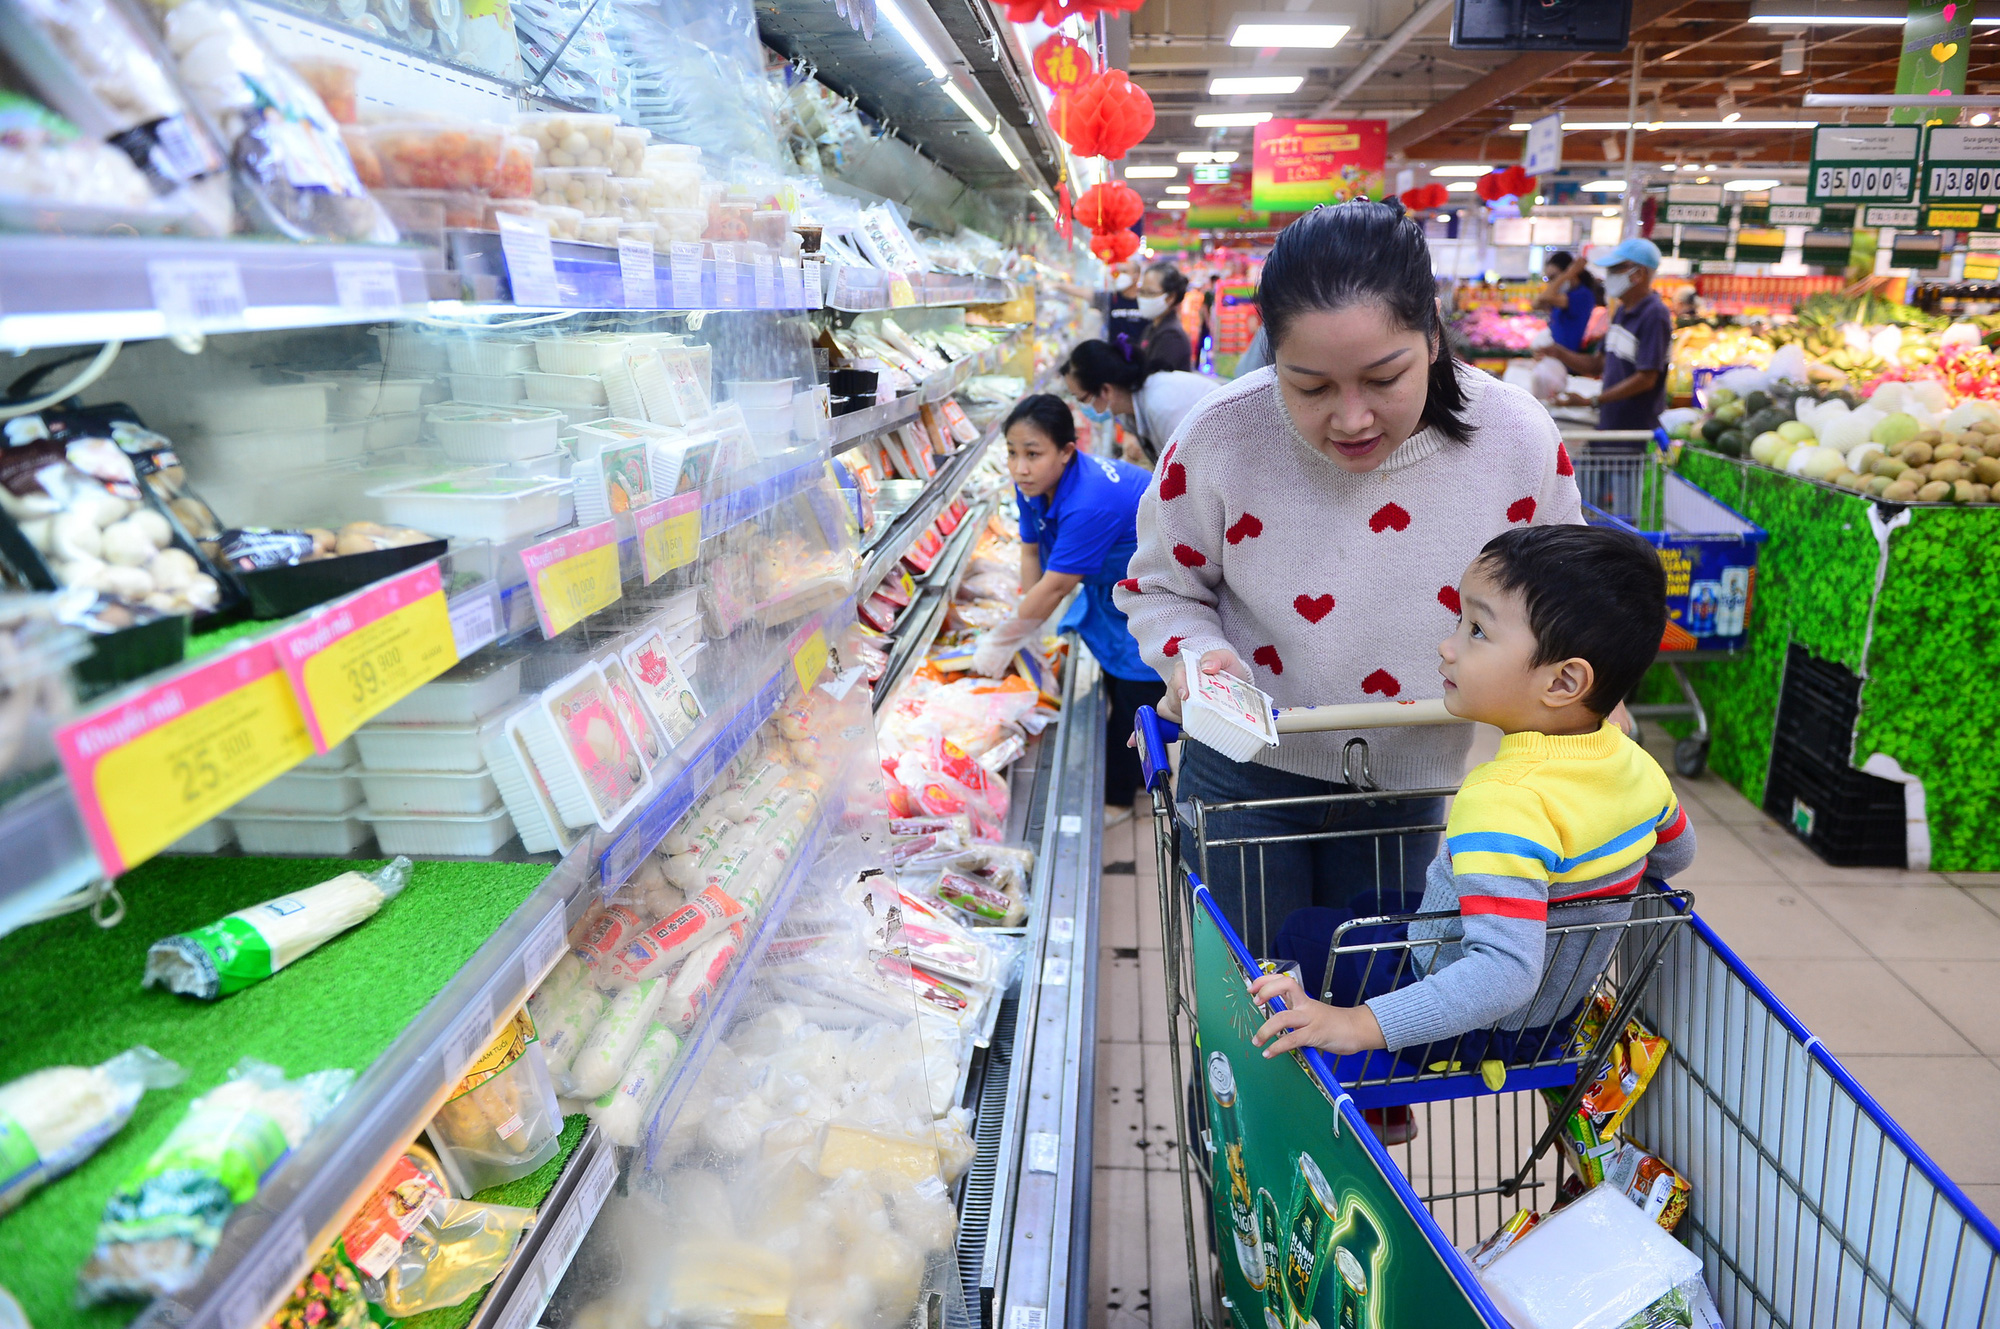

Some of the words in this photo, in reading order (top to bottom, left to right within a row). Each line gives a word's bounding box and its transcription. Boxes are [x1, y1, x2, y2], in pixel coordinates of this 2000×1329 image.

[1045, 45, 1078, 84] 福
[1820, 171, 1894, 189] 35.000
[348, 660, 380, 703] 39
[171, 748, 220, 803] 25
